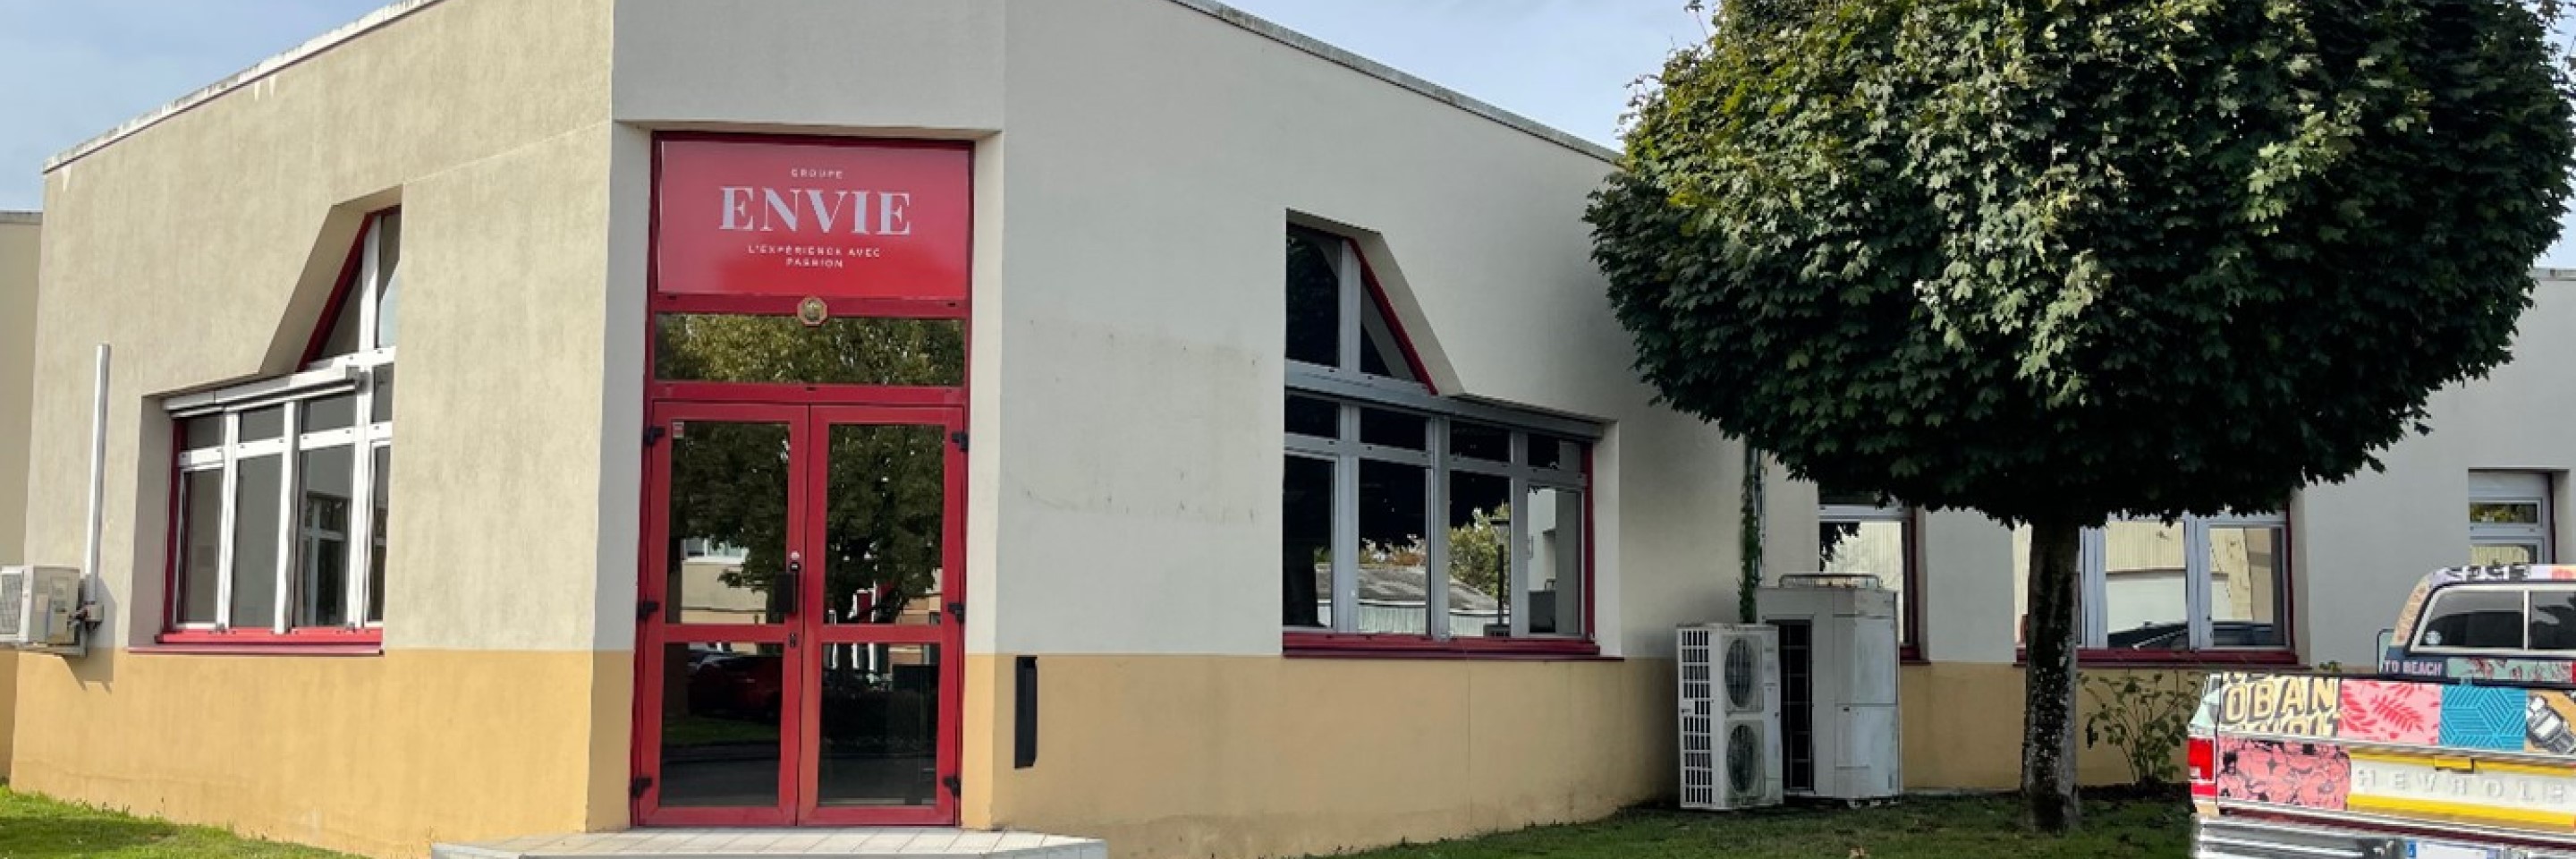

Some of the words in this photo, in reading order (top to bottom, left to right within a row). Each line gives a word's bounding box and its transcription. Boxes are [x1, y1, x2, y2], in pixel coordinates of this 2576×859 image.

[791, 168, 843, 180] GROUPE
[719, 185, 911, 235] ENVIE
[848, 247, 880, 258] AVEC
[785, 258, 843, 268] PASSION
[2402, 659, 2443, 676] BEACH
[2358, 769, 2564, 804] HEVROLE
